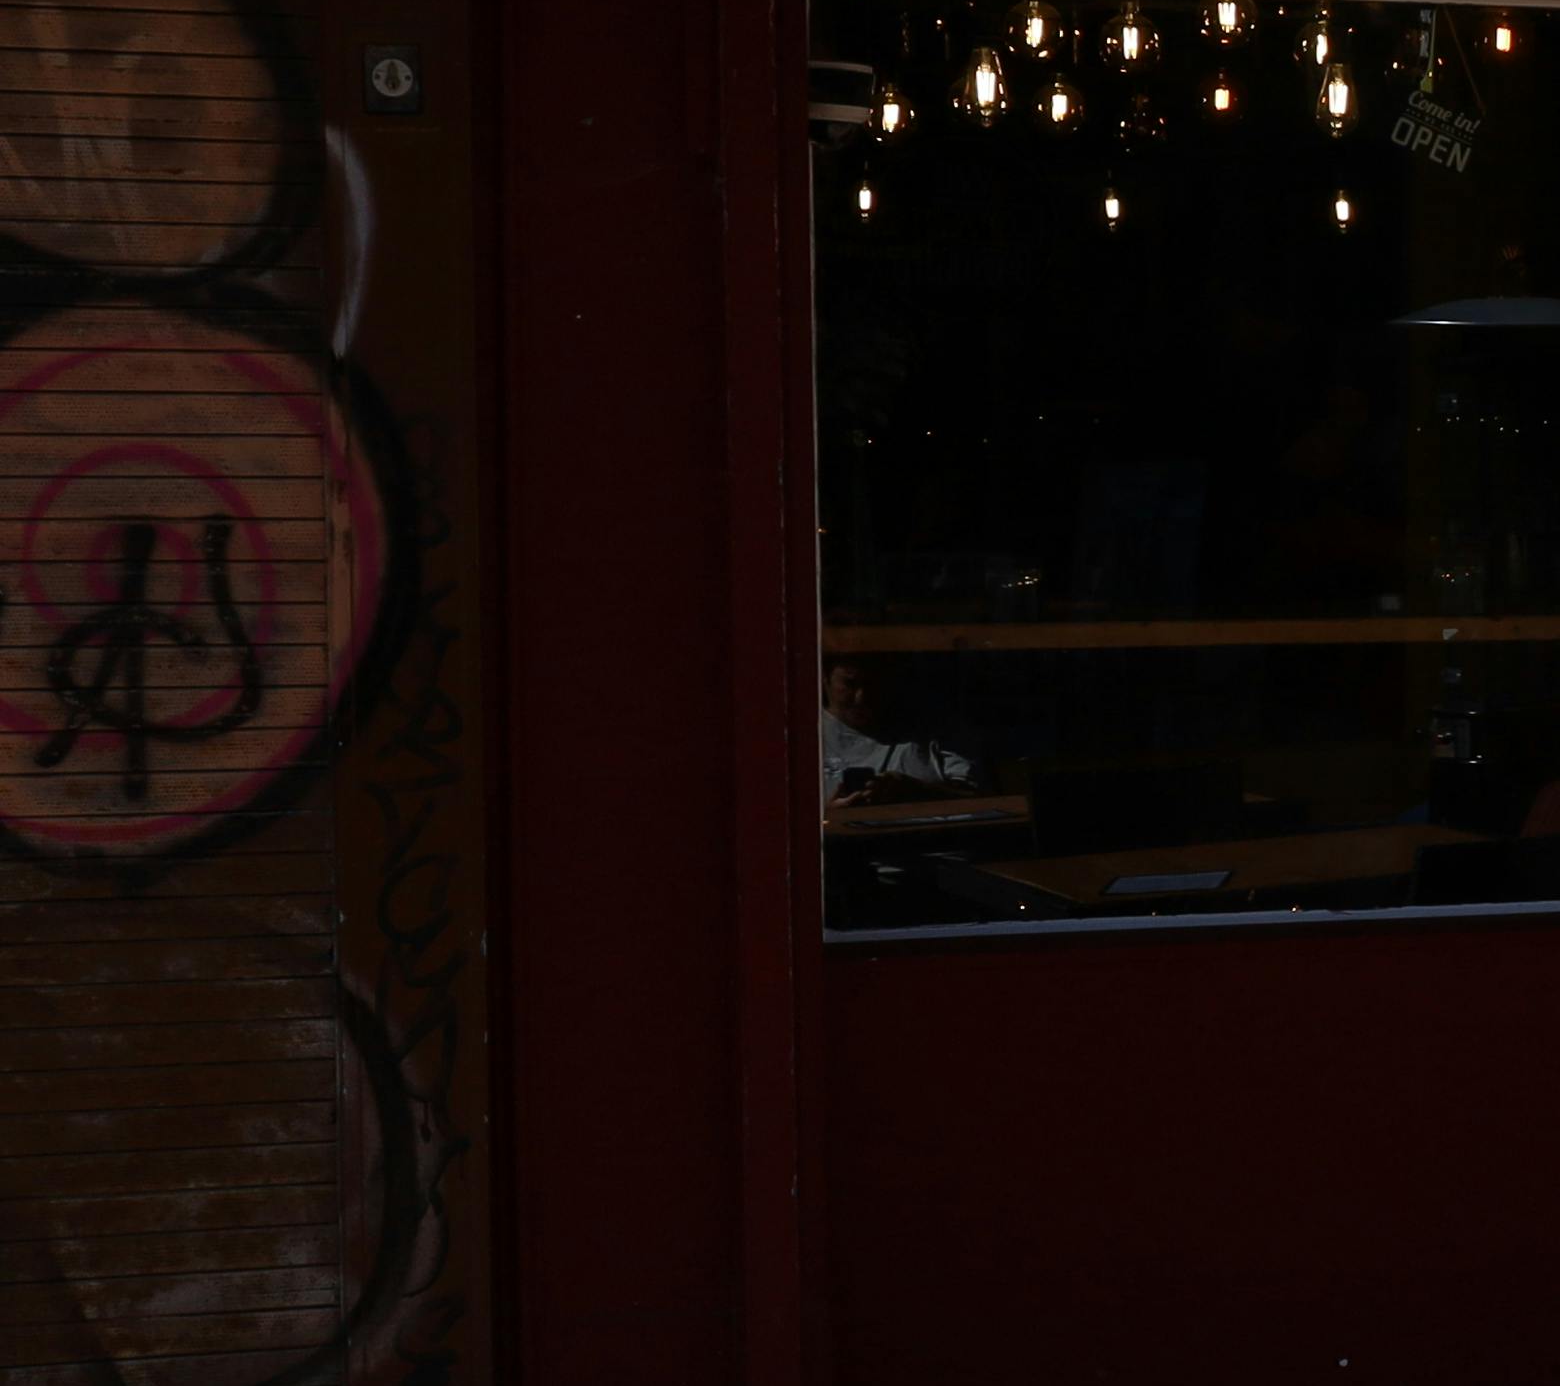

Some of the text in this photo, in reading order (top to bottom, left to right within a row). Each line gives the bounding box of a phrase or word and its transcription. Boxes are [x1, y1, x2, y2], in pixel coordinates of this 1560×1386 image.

[1407, 89, 1453, 122] Come
[1453, 111, 1482, 134] in!
[1391, 115, 1472, 174] OPEN
